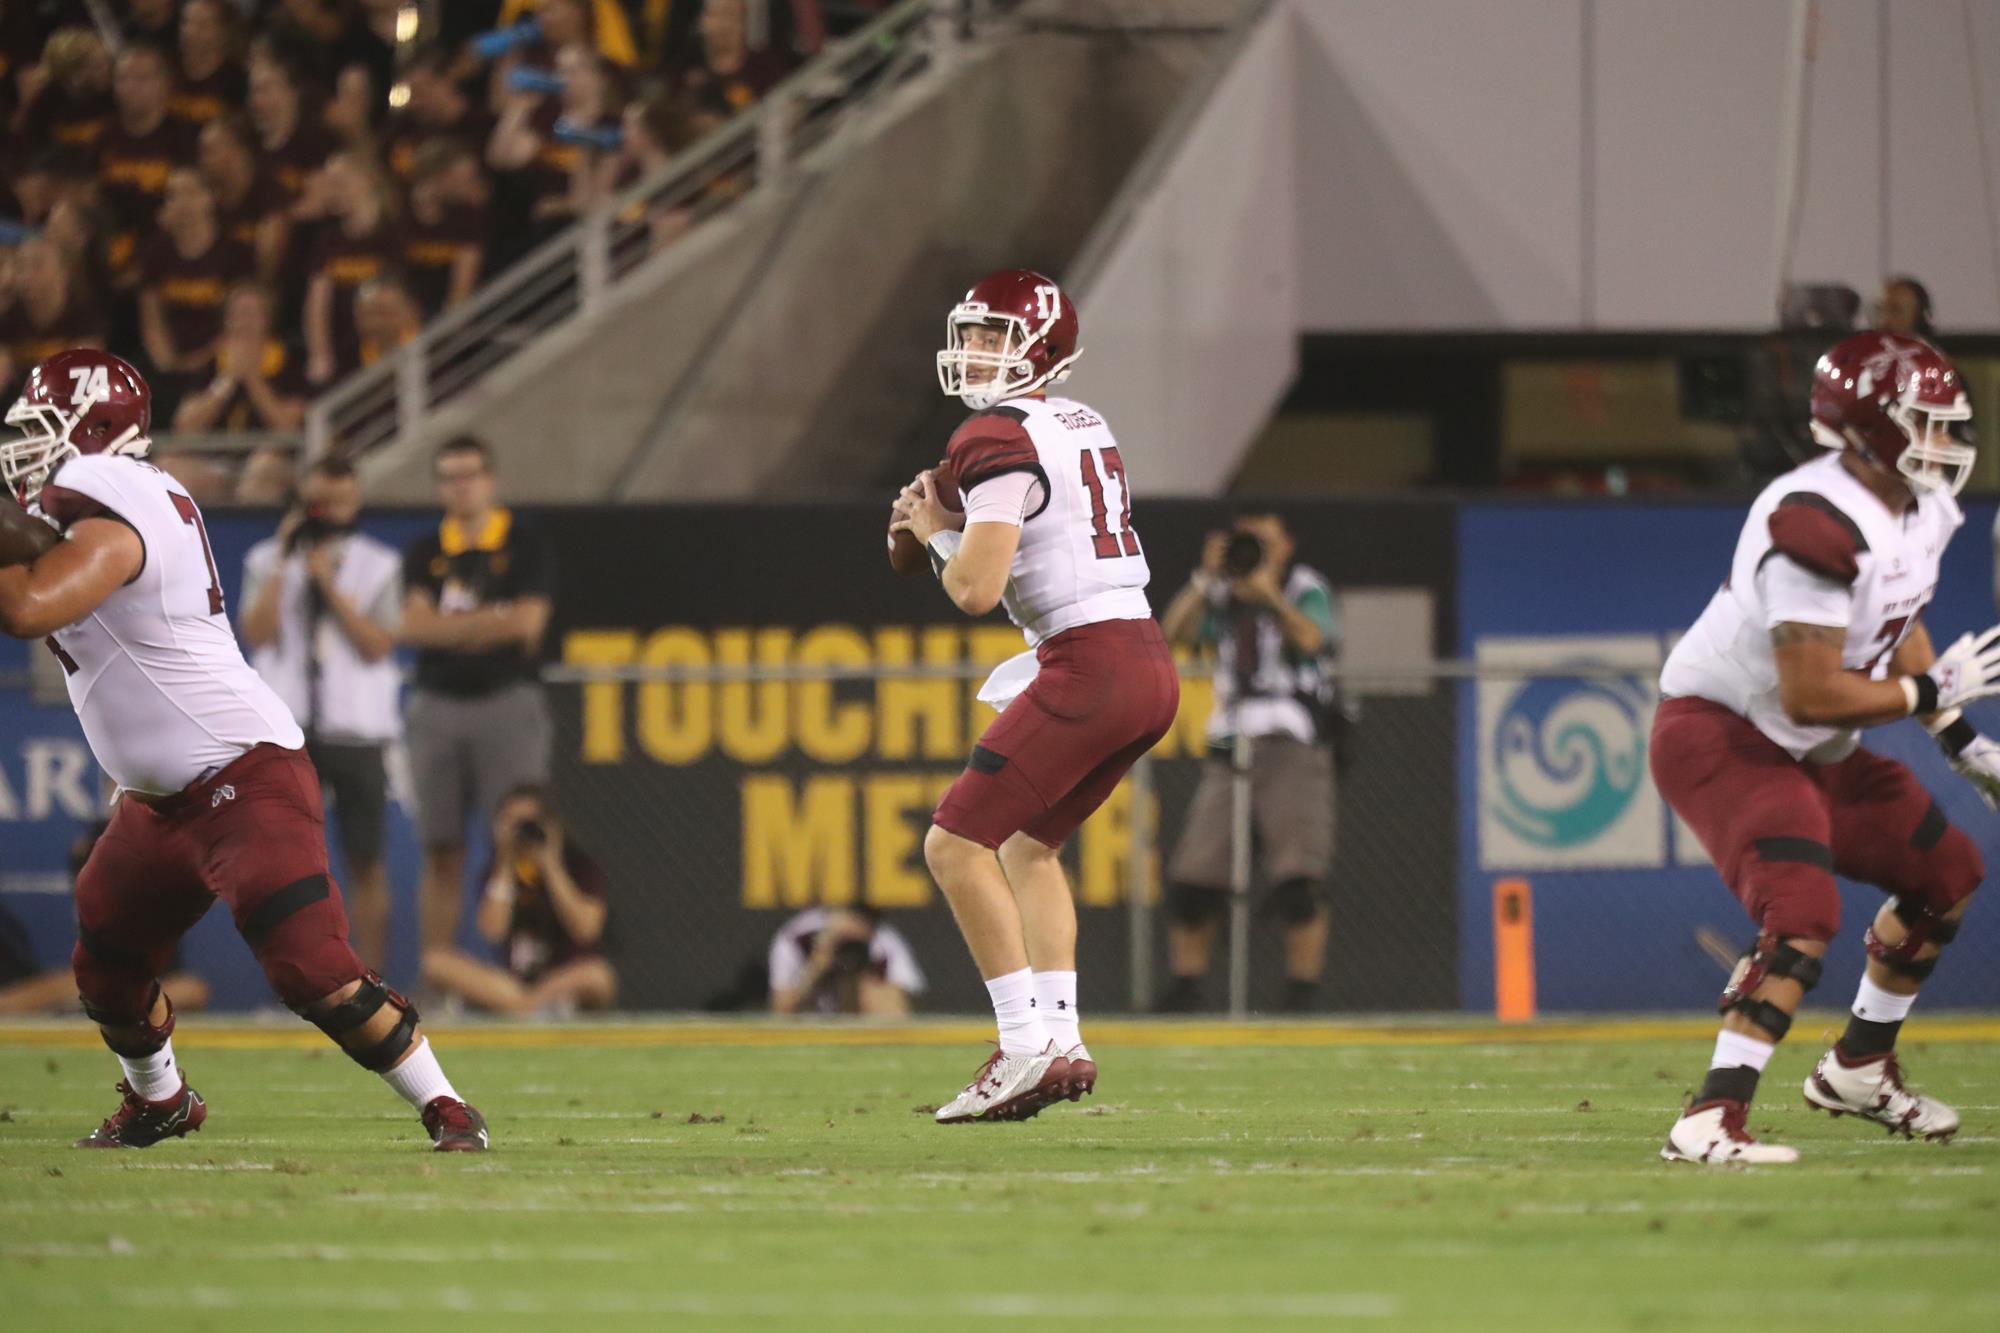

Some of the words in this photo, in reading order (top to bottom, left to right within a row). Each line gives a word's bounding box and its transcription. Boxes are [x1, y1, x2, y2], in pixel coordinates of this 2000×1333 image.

[1034, 285, 1061, 319] 17
[69, 365, 110, 404] 74
[1080, 446, 1141, 560] 17
[563, 625, 1212, 760] TOUCHN
[742, 774, 1161, 908] MER
